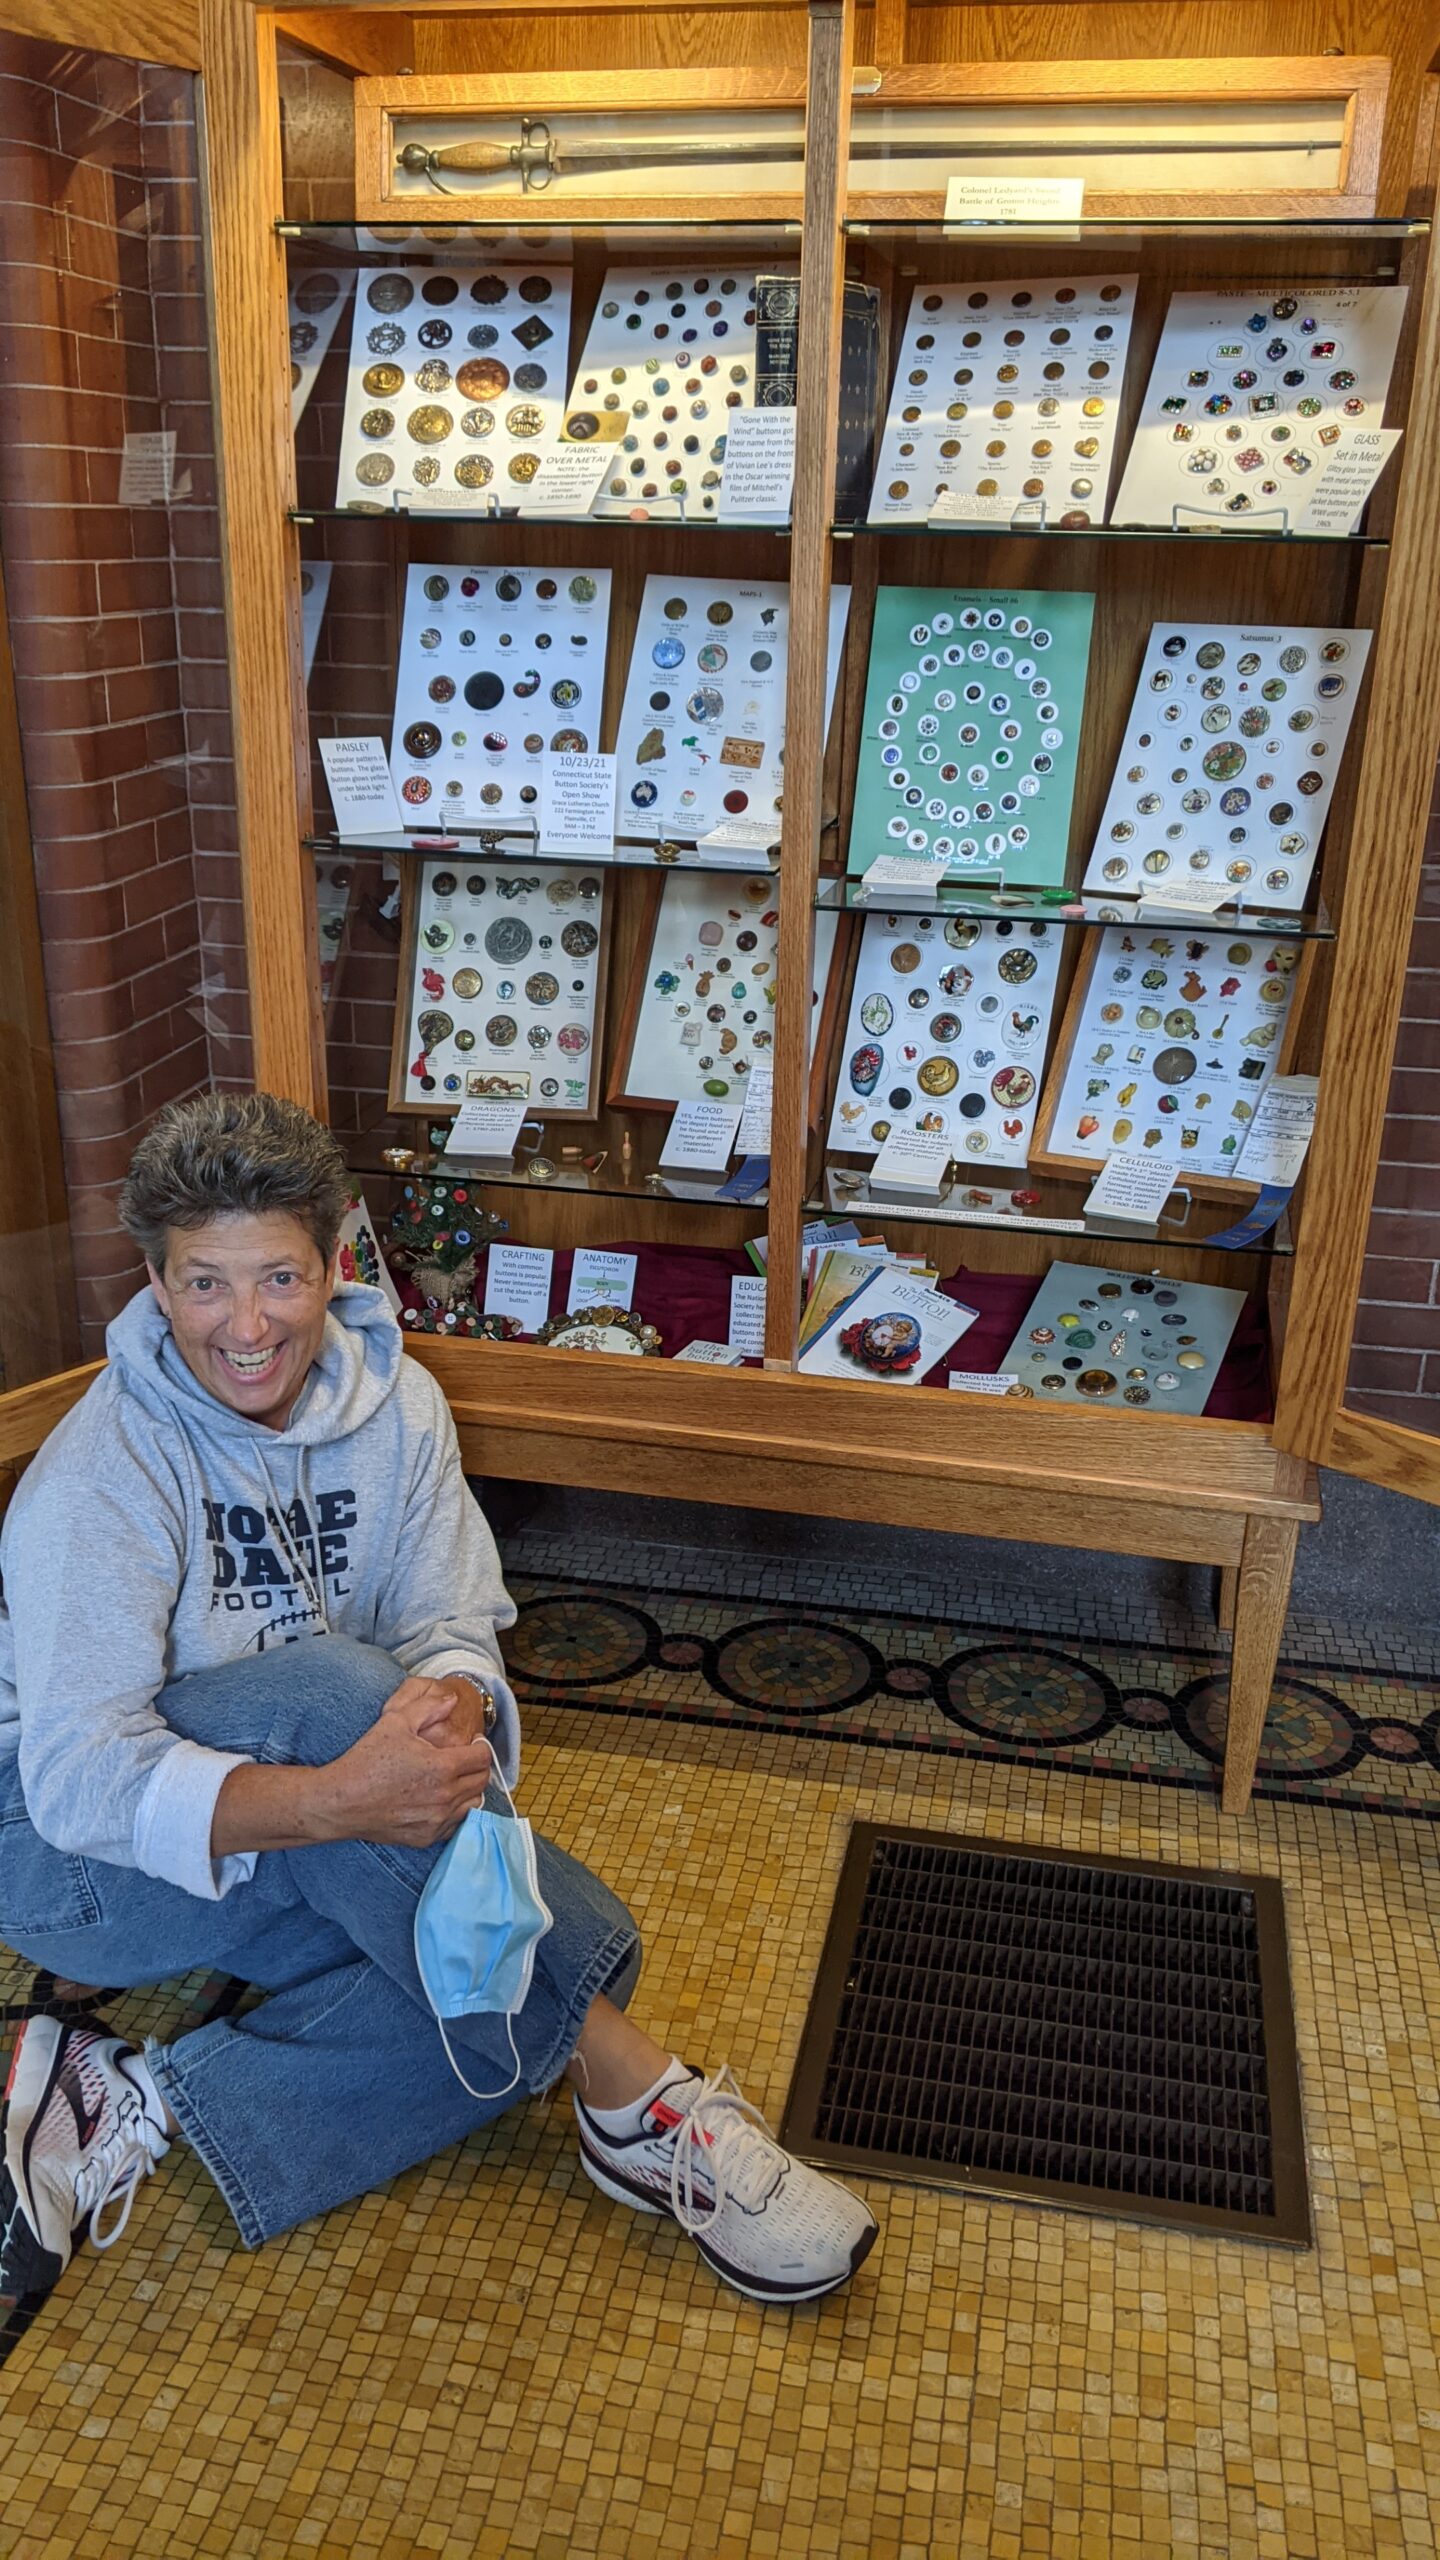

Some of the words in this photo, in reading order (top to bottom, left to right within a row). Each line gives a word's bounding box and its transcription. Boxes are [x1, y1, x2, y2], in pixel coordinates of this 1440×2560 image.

[961, 186, 992, 194] Colonel
[762, 415, 778, 424] With
[779, 415, 791, 423] the
[756, 427, 781, 435] buttons
[783, 427, 794, 436] got
[1353, 434, 1382, 445] GLASS
[564, 446, 600, 454] FABRIC
[546, 456, 573, 465] OVER
[575, 455, 607, 464] METAL
[1334, 450, 1349, 461] Set
[1349, 451, 1358, 461] in
[1358, 450, 1384, 462] Metal
[735, 461, 755, 469] Vivian
[765, 473, 791, 481] winning
[335, 742, 370, 752] PAISLEY
[560, 756, 606, 768] 10/23/21
[552, 769, 592, 779] Connecticut
[594, 771, 612, 779] State
[554, 780, 578, 788] Button
[579, 781, 608, 790] Society's
[562, 790, 581, 799] Open
[582, 791, 601, 799] Show
[547, 830, 578, 840] Everyone
[580, 831, 611, 840] Welcome
[470, 1105, 516, 1113] DRAGONS
[696, 1106, 723, 1114] FOOD
[900, 1129, 950, 1140] ROOSTERS
[1118, 1156, 1173, 1171] CELLULOID
[501, 1249, 546, 1262] CRAFTING
[582, 1253, 628, 1265] ANATOMY
[502, 1261, 517, 1269] With
[495, 1269, 518, 1277] buttons
[733, 1302, 754, 1310] Society
[735, 1311, 764, 1319] collectors
[732, 1320, 760, 1328] educated
[731, 1329, 755, 1337] buttons
[703, 1343, 724, 1351] the
[687, 1345, 729, 1360] button
[959, 1373, 1010, 1382] MOLLUSKS
[201, 1489, 358, 1545] NOE
